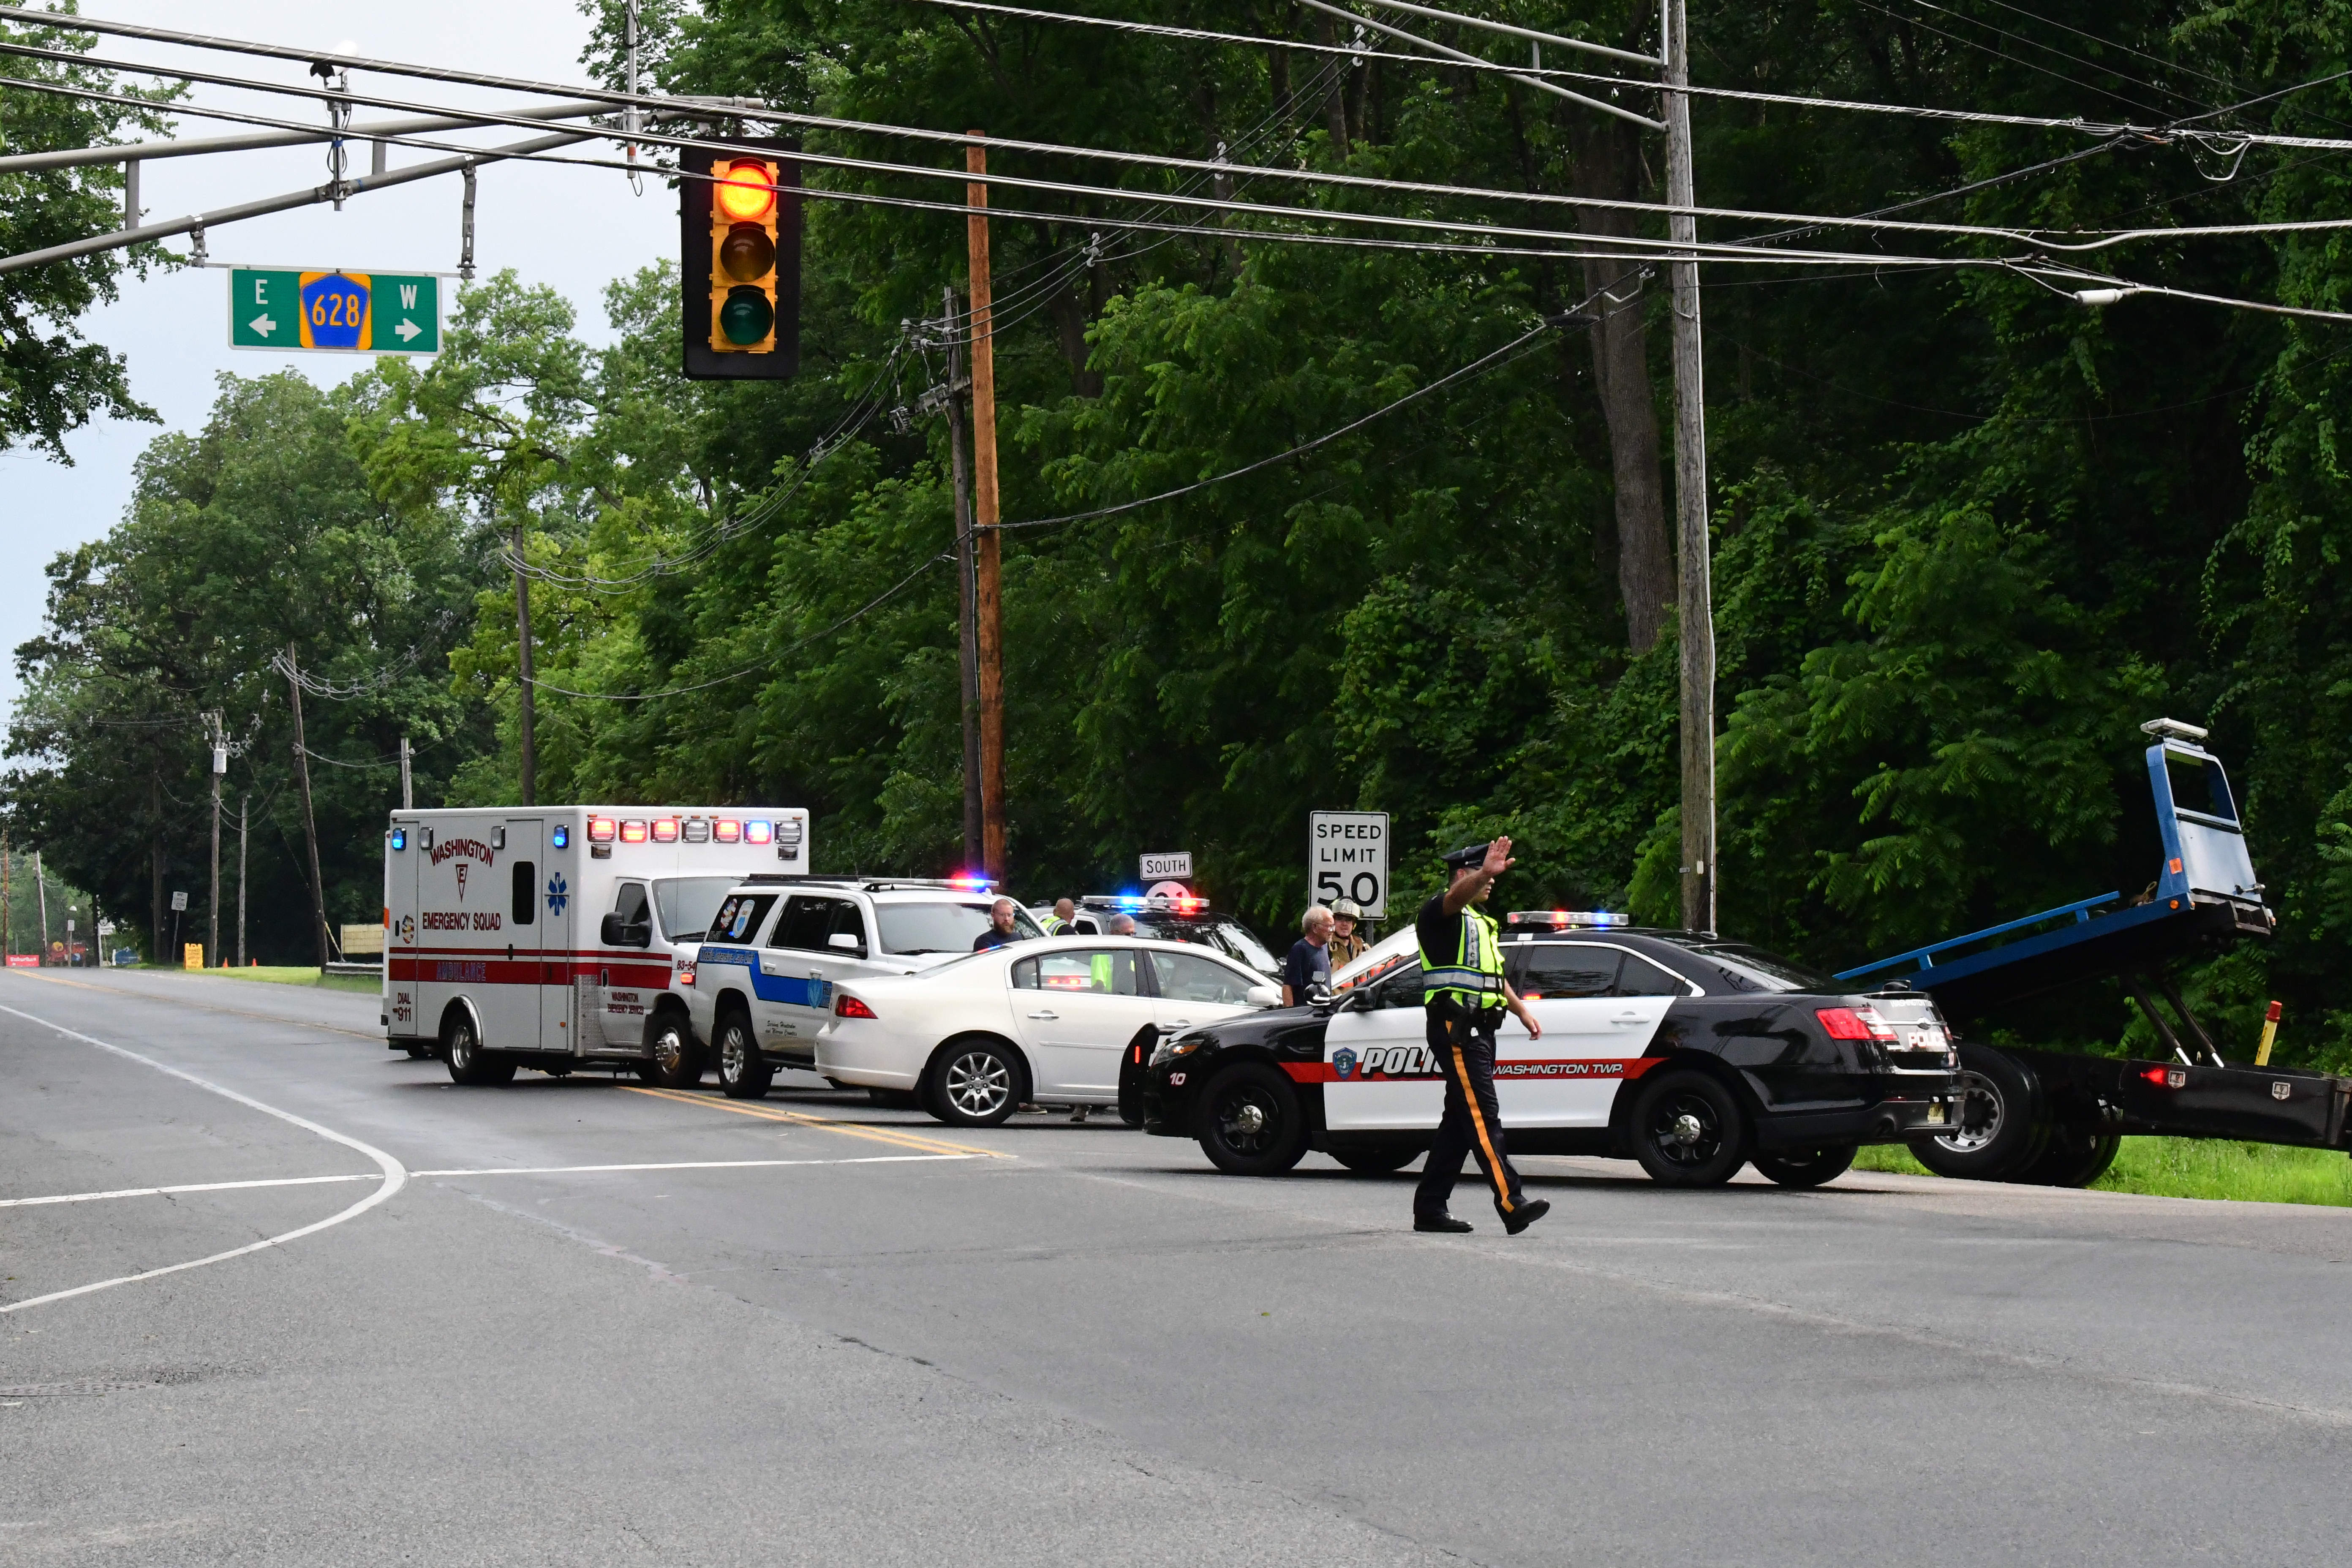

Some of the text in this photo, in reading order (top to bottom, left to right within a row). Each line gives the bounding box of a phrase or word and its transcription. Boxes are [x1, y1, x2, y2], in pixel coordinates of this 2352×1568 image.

[256, 279, 268, 304] E
[400, 284, 417, 310] W
[312, 294, 359, 327] 628
[1317, 824, 1381, 839] SPEED
[430, 839, 494, 867] WASHINGTON
[1321, 848, 1376, 863] LIMIT
[1146, 860, 1186, 873] SOUTH
[459, 868, 464, 881] E
[1317, 871, 1379, 906] 50
[423, 912, 501, 931] EMERGENCY SQUAD
[436, 962, 486, 981] AMBULANCE
[677, 960, 697, 970] 83-54
[398, 993, 411, 1004] DIAL
[612, 992, 638, 1002] WASHINGTON
[398, 1007, 411, 1021] 911
[1908, 1032, 1946, 1049] POLICE
[1360, 1047, 1443, 1078] POLI
[1493, 1064, 1624, 1075] WASHINGTON TWP.
[1170, 1073, 1186, 1085] 10
